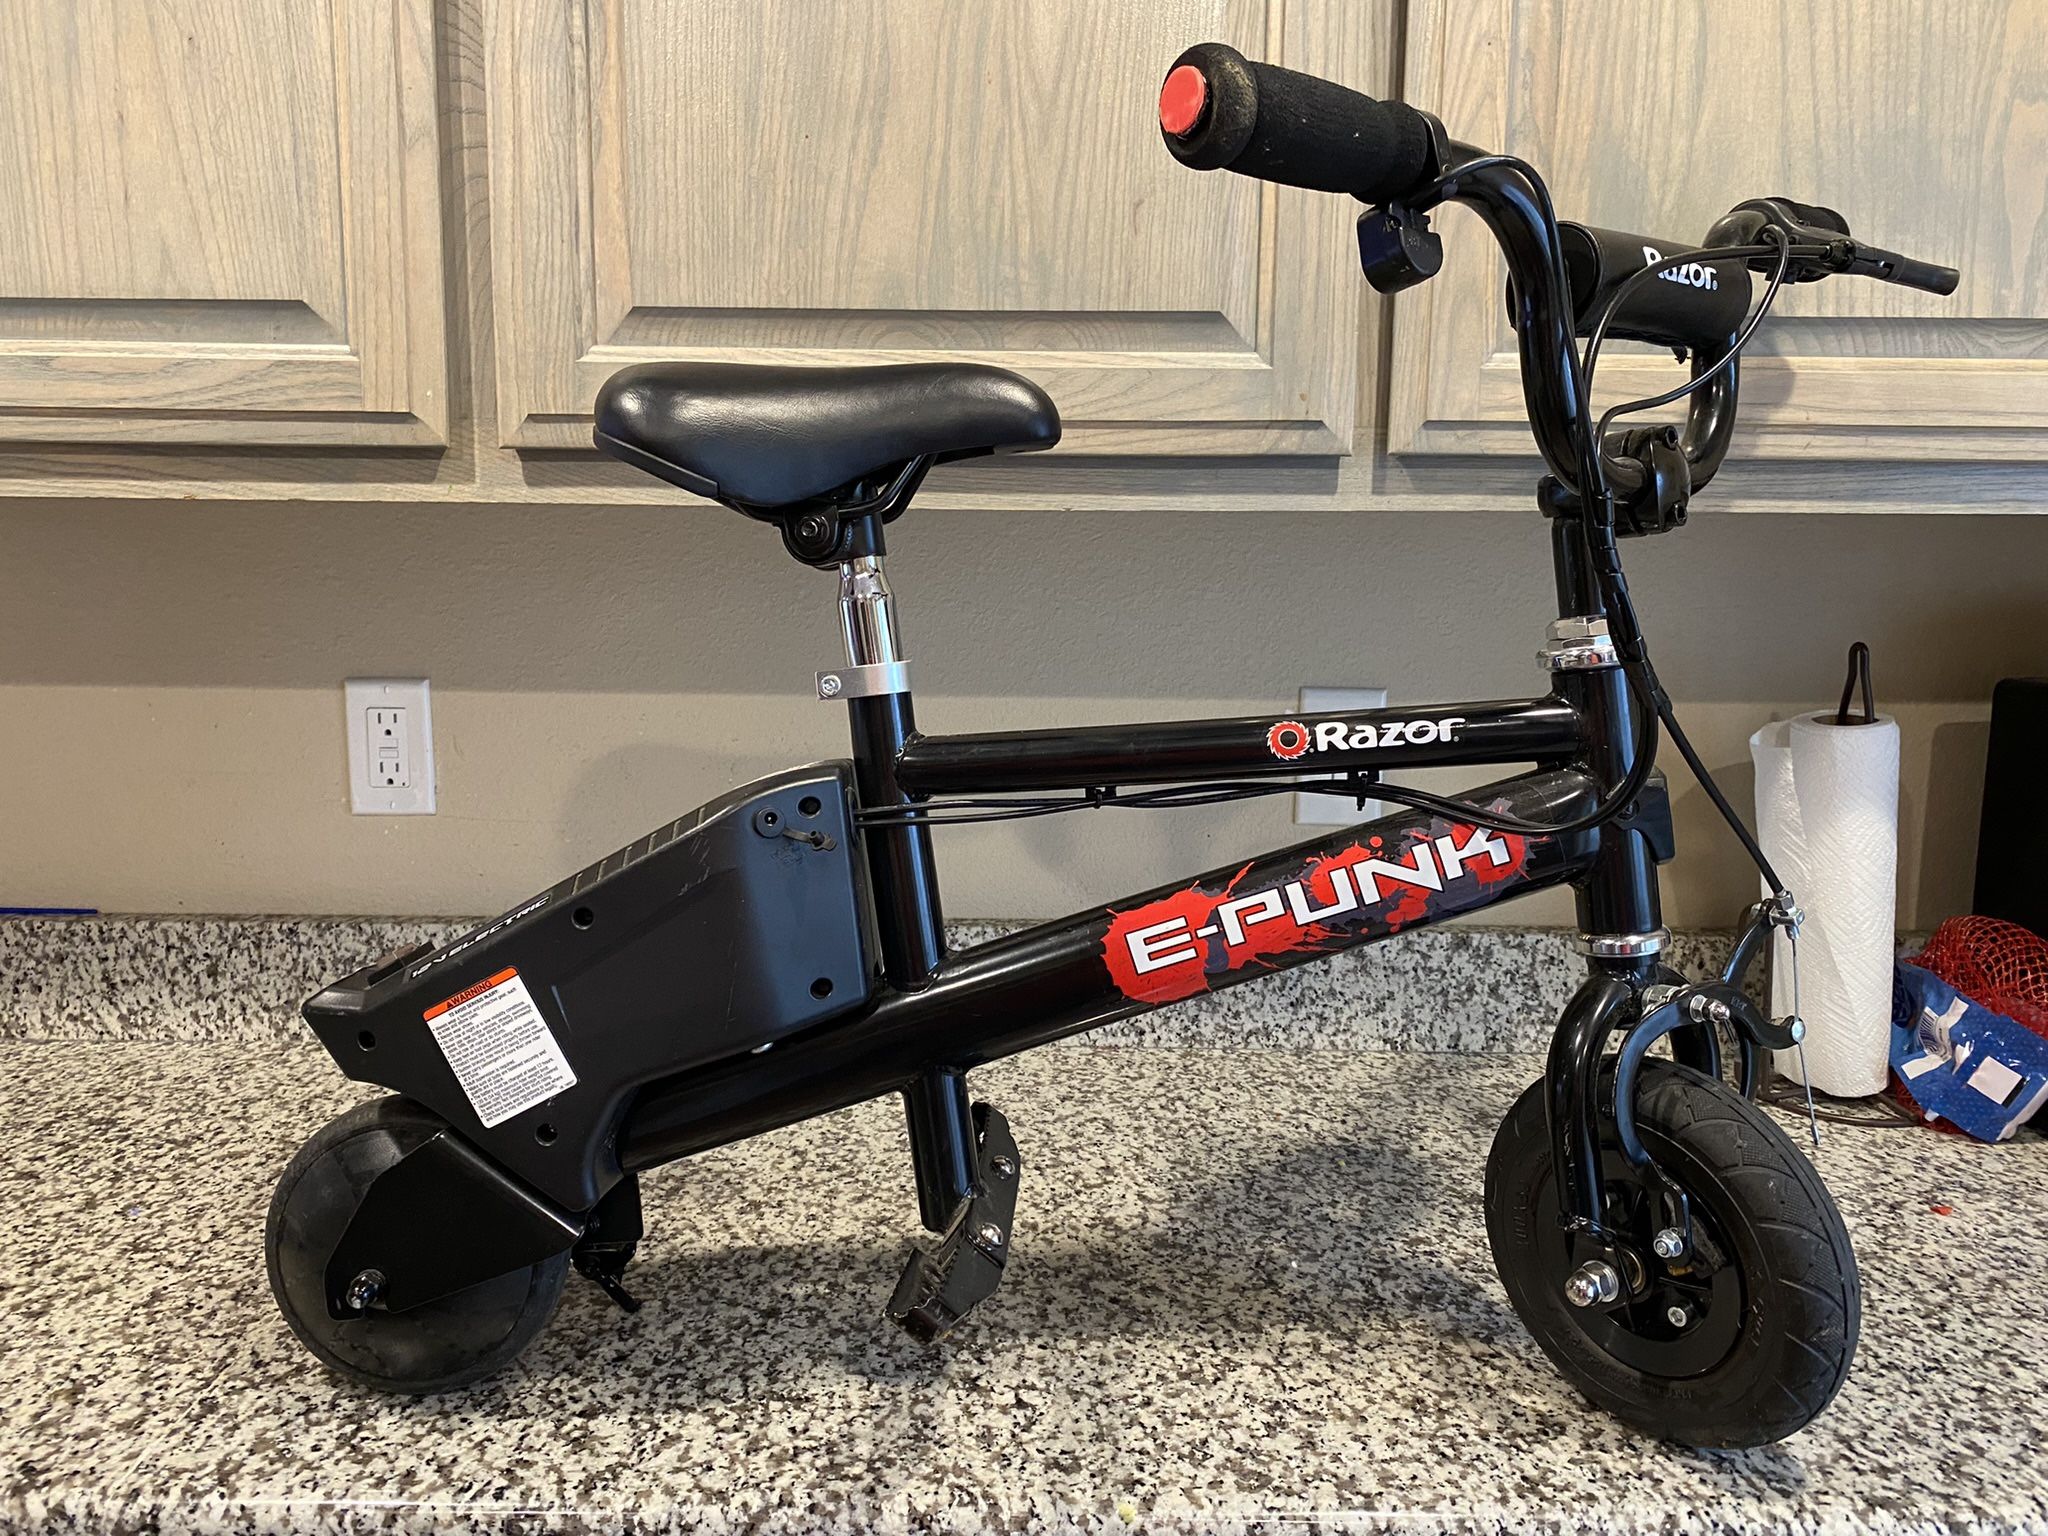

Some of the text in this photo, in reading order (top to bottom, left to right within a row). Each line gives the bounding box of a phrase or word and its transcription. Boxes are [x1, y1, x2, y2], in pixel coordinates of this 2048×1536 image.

[1315, 718, 1466, 752] Razor
[1125, 826, 1511, 975] E-PUNK
[451, 980, 492, 1005] WARNING
